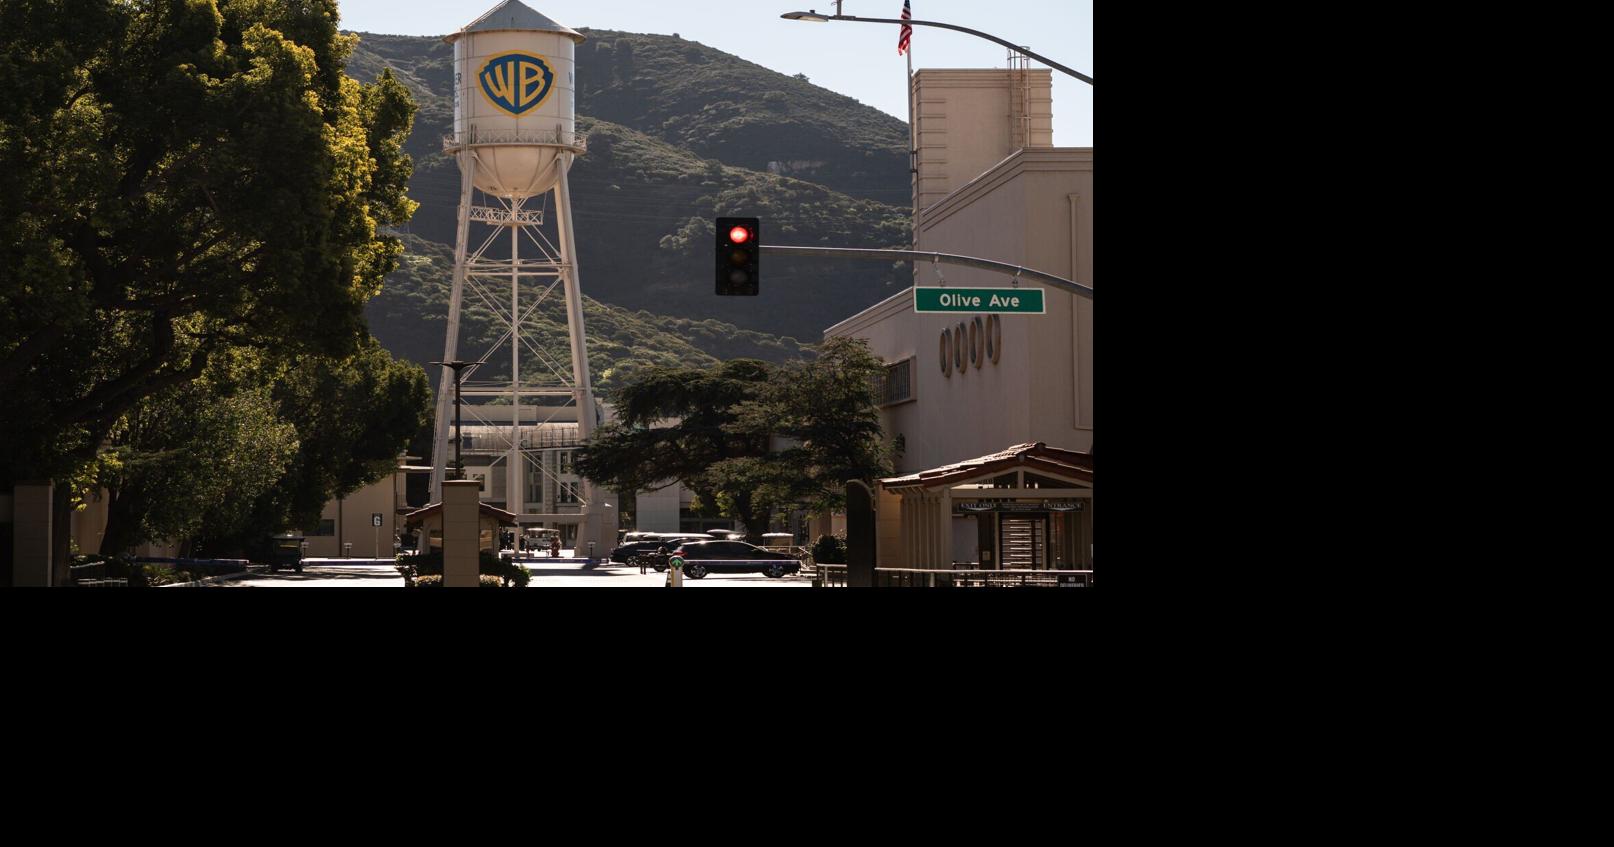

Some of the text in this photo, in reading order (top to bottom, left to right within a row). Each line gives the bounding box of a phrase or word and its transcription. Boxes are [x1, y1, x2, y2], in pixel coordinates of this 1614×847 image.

[484, 60, 546, 108] WB
[940, 293, 1020, 307] Olive Ave
